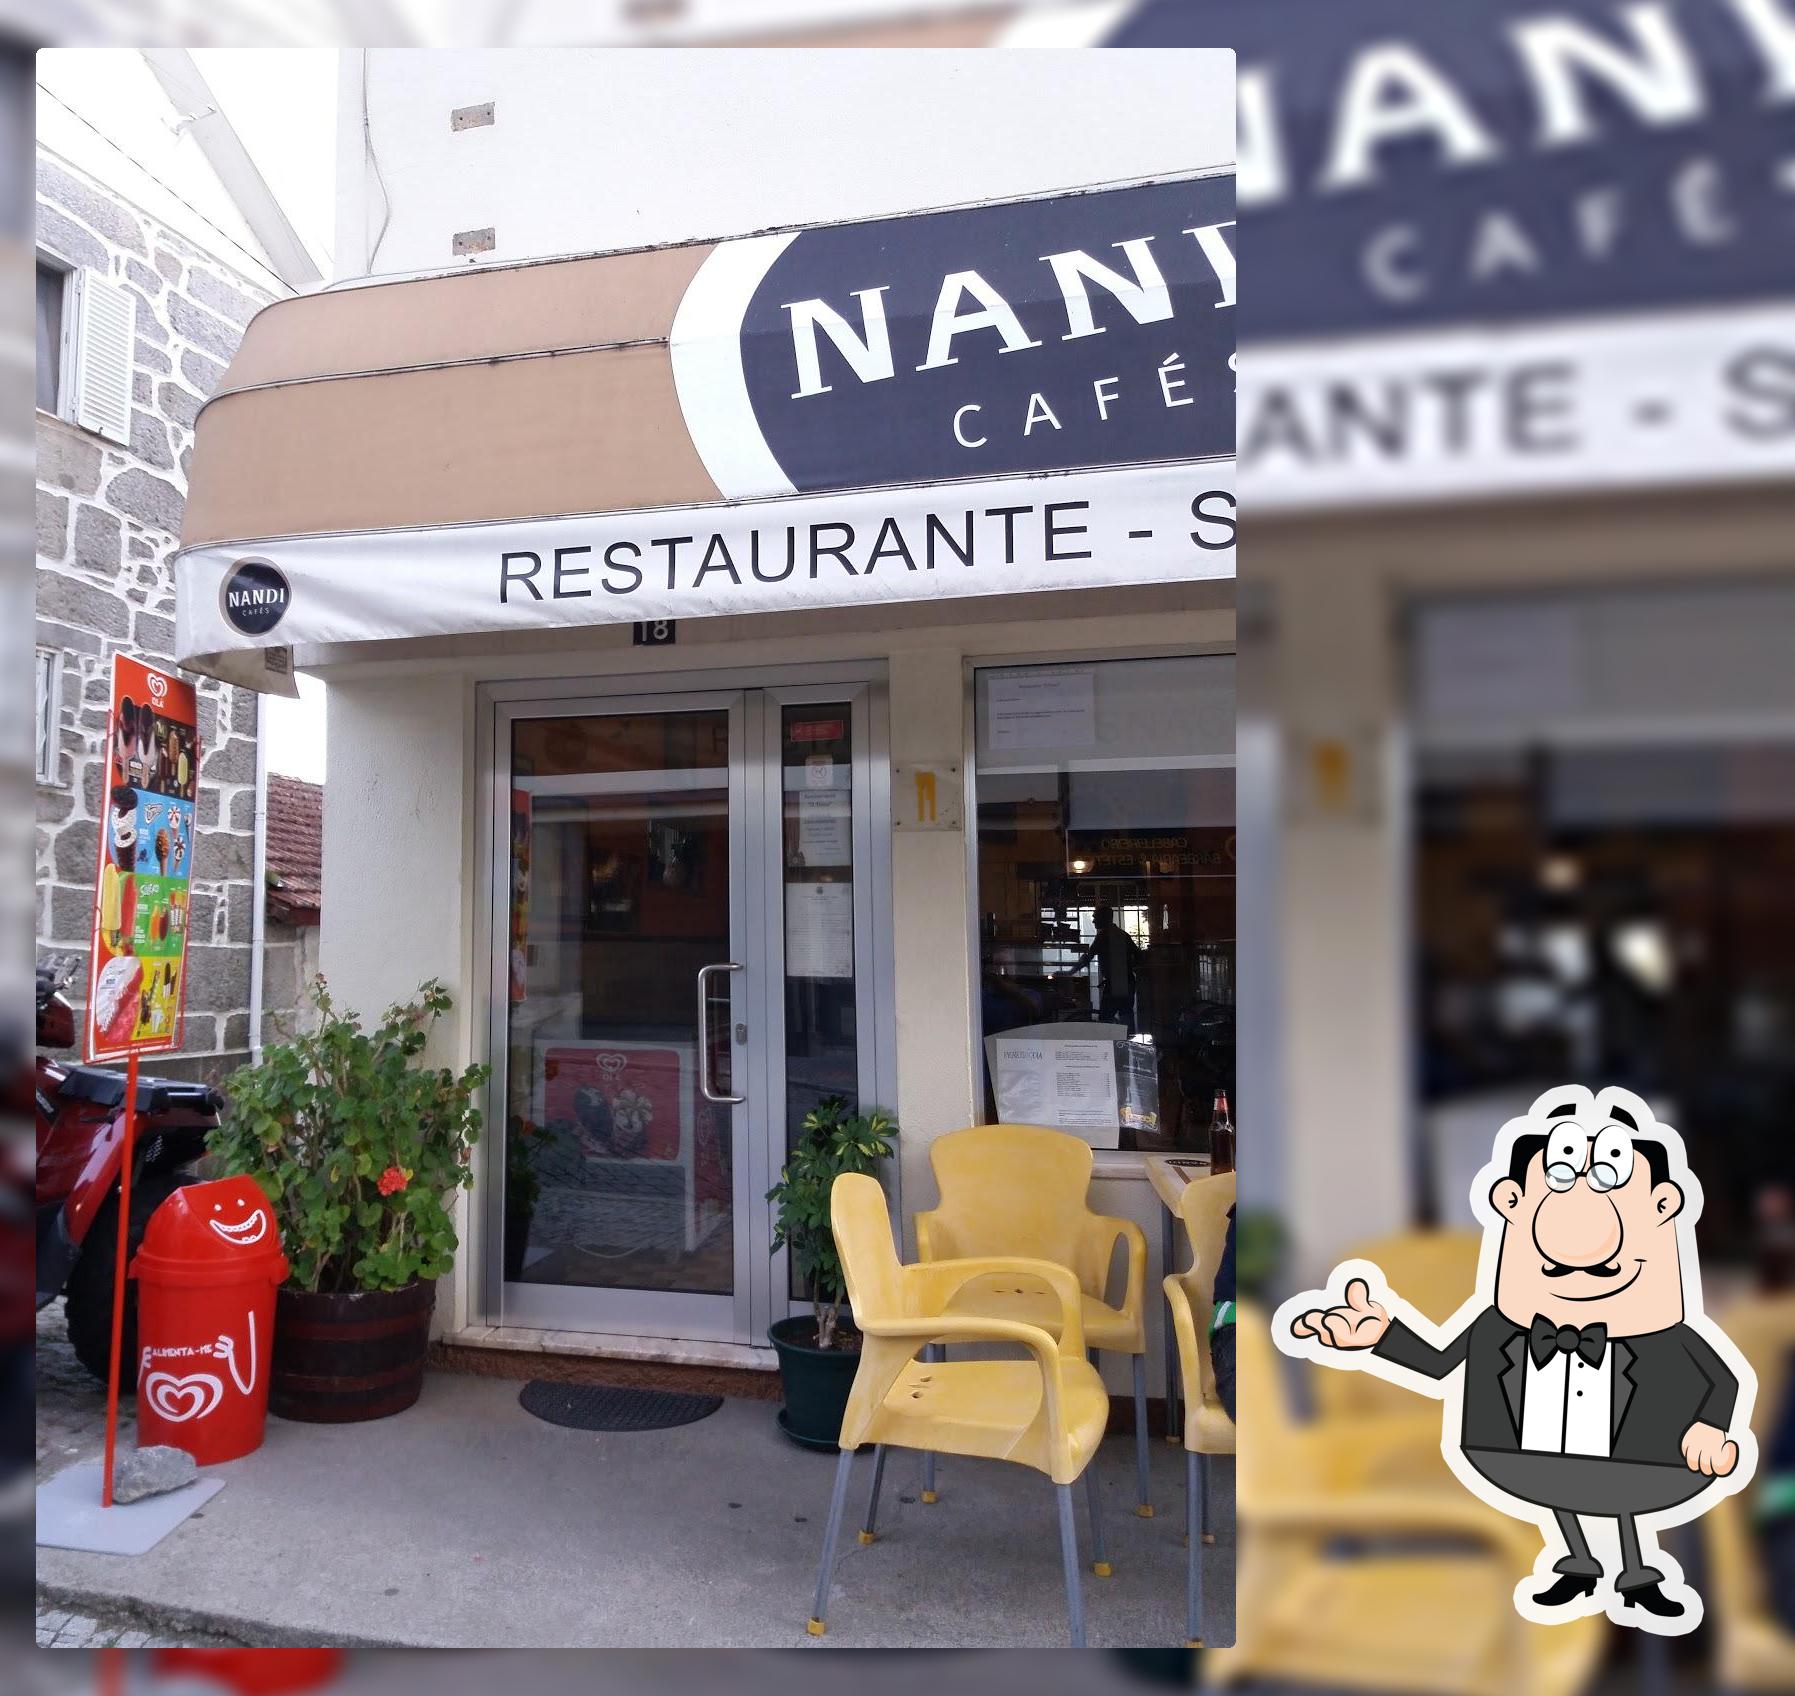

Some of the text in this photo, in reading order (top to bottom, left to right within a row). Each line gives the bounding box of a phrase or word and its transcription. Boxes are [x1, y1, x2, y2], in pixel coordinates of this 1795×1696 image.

[952, 352, 1236, 448] CAFÉ
[499, 501, 1092, 603] RESTAURANTE
[228, 588, 285, 607] NANDI
[641, 620, 669, 642] 18
